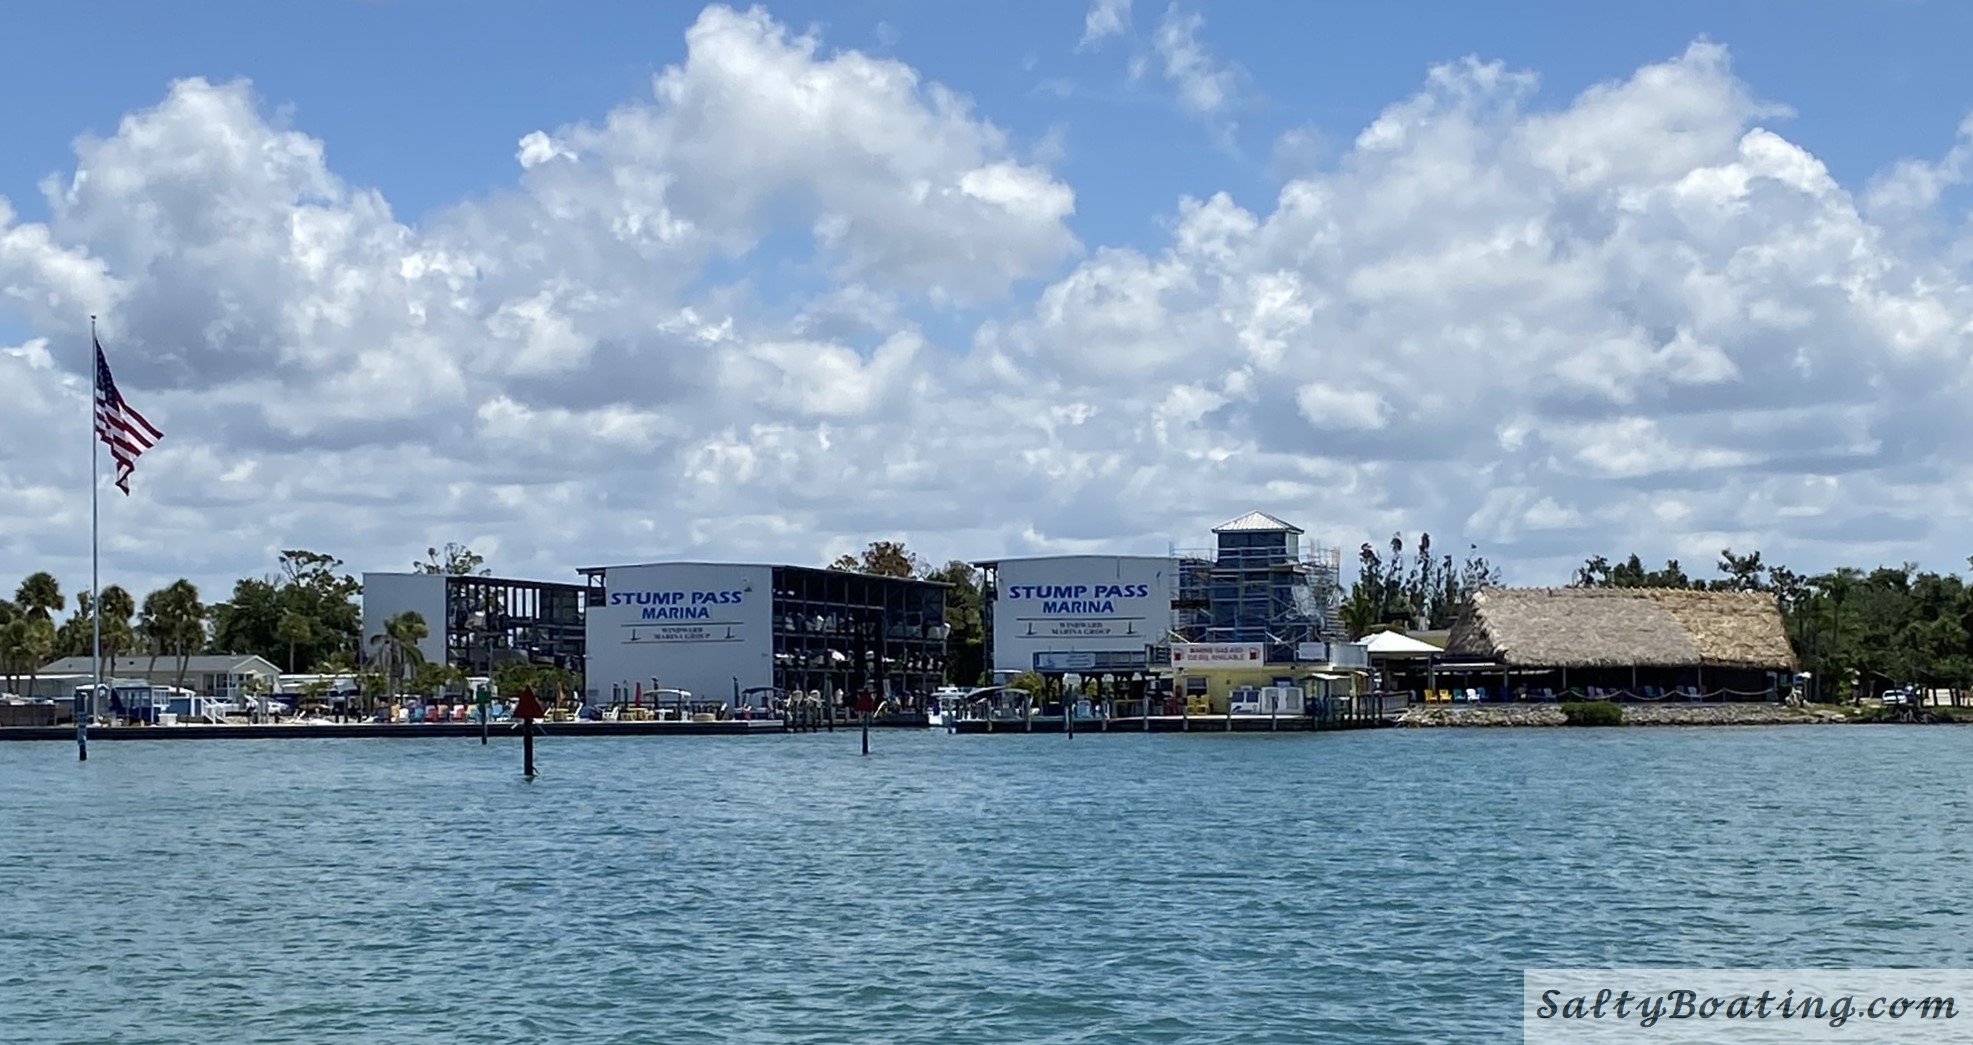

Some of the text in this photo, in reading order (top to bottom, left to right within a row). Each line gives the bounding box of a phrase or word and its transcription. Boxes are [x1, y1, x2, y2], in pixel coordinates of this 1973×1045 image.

[611, 591, 742, 605] STUMP PASS
[1009, 584, 1148, 599] STUMP PASS
[642, 607, 710, 619] MARINA
[1042, 601, 1114, 613] MARINA
